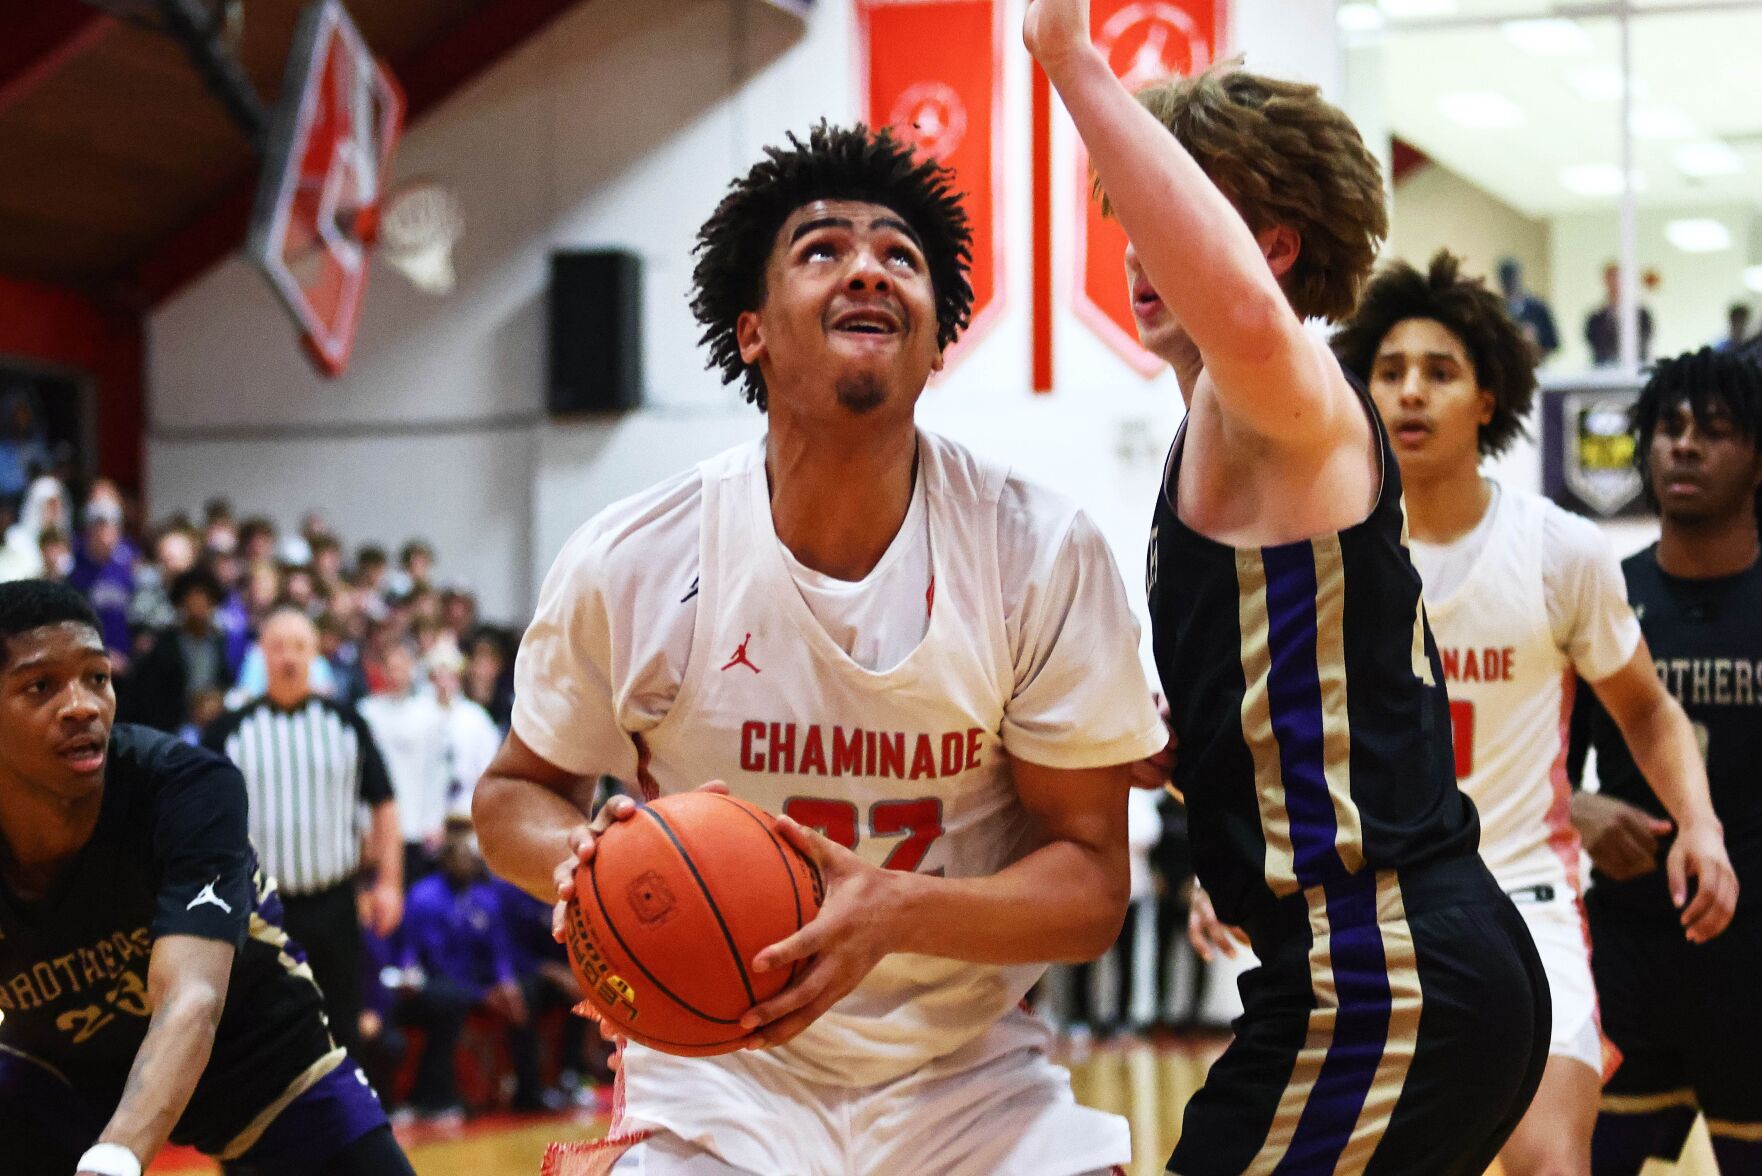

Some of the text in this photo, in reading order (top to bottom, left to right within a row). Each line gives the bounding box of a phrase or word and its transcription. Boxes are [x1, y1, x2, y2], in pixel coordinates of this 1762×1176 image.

[1441, 646, 1516, 682] NADE
[740, 720, 985, 781] CHAMINADE
[0, 927, 150, 1010] ROTHERS
